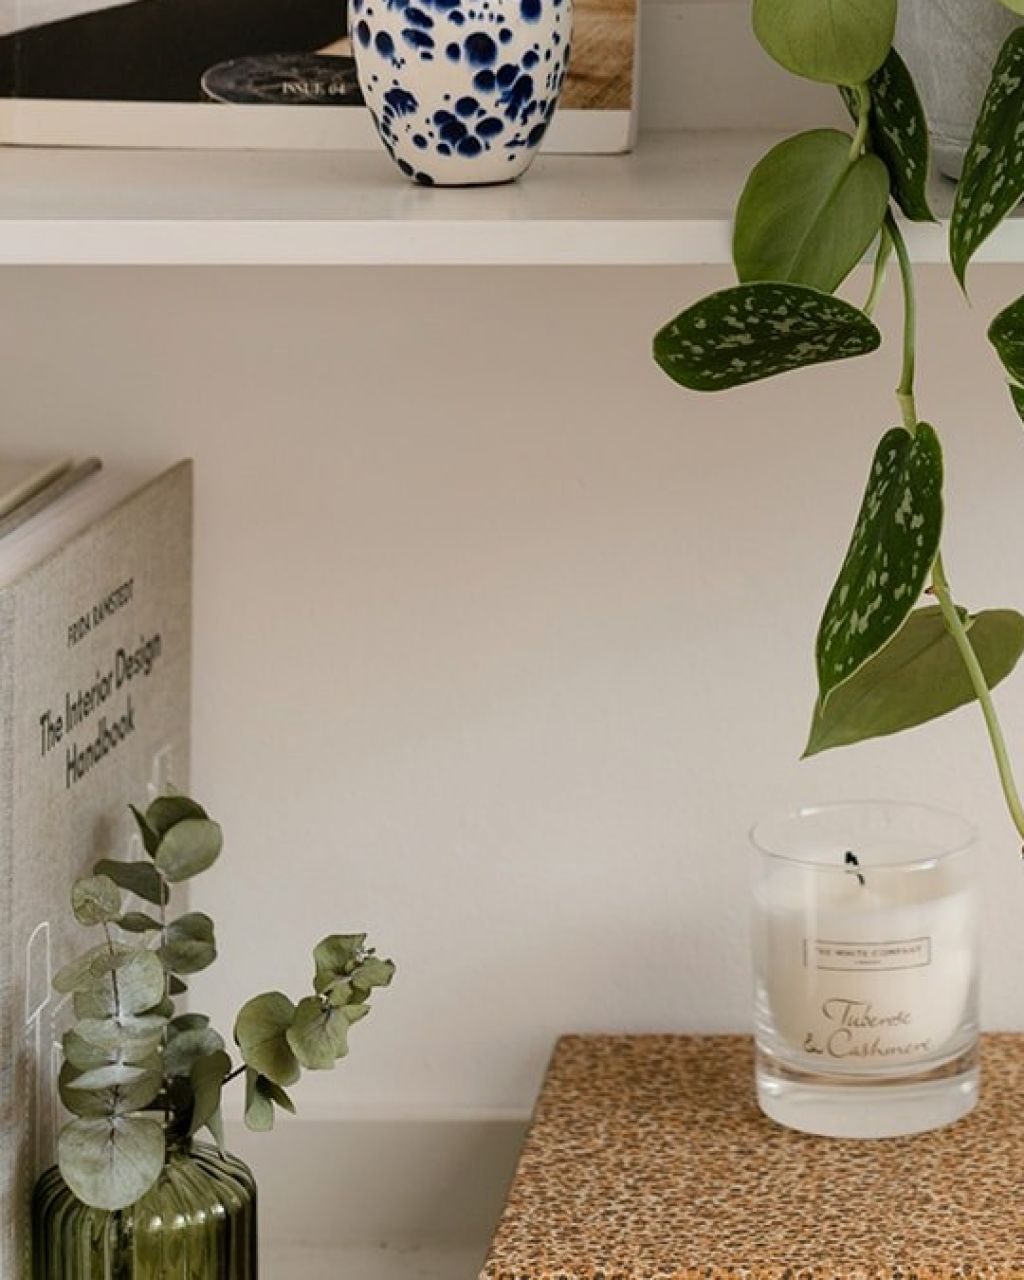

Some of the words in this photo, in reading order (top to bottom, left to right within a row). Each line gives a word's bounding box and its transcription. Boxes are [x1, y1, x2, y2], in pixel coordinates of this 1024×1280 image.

[40, 709, 63, 756] The
[66, 669, 114, 734] Interior
[115, 633, 162, 690] Design
[66, 693, 135, 790] Handbook
